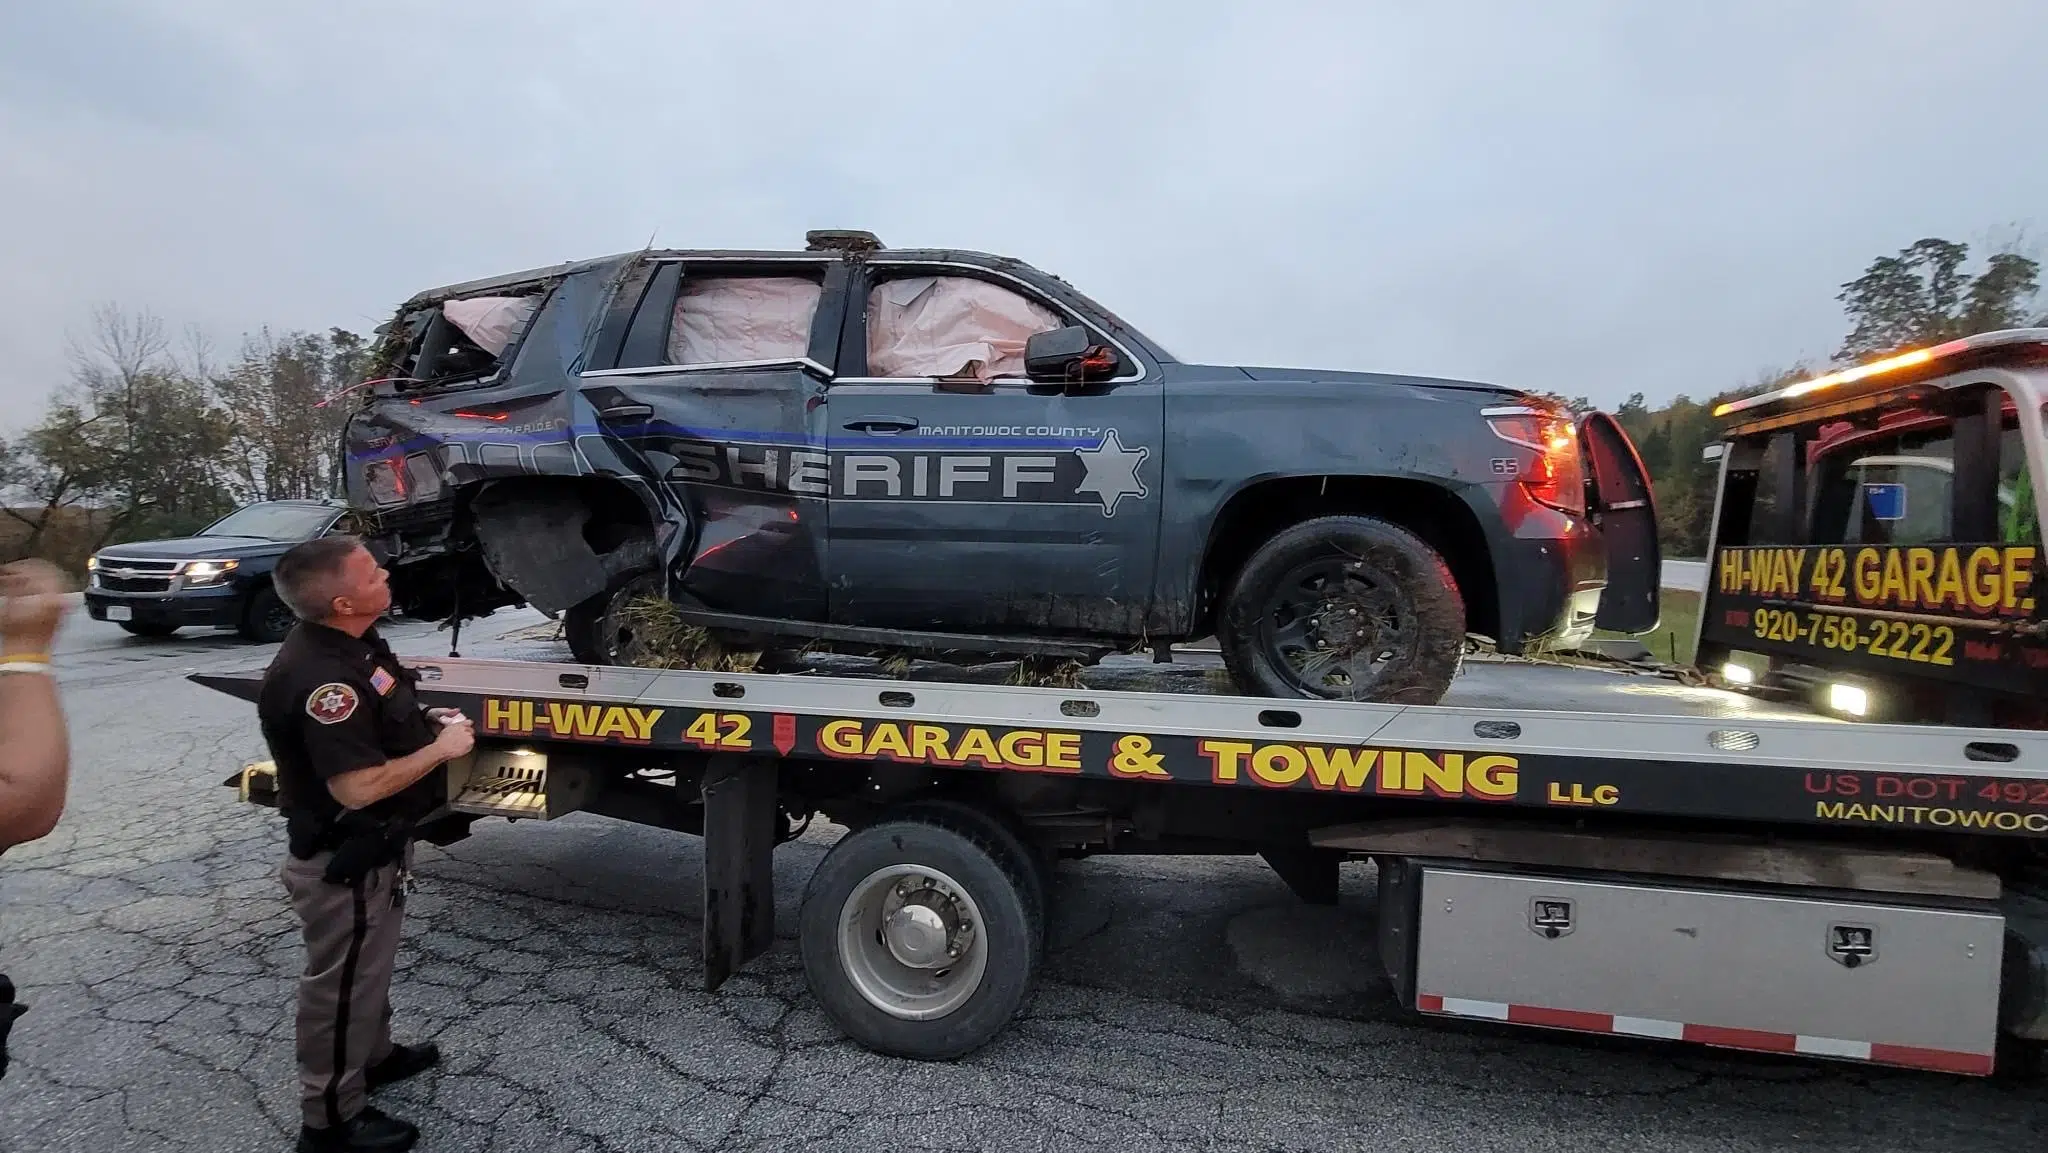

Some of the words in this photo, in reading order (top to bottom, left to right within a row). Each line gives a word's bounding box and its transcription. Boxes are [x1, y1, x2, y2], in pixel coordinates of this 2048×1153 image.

[919, 425, 1023, 437] MANITOWOC
[1025, 425, 1101, 438] COUNTY
[670, 443, 1057, 497] SHERIFF
[1489, 457, 1520, 475] 65
[1719, 548, 1806, 595] HI-WAY
[1811, 548, 1848, 598] 42
[1854, 547, 2036, 613] GARAGE
[1754, 608, 1955, 666] 920-758-2222
[484, 699, 665, 744] HI-WAY
[684, 713, 752, 750] 42
[817, 720, 1083, 773] GARAGE
[1108, 735, 1173, 779] &
[1198, 741, 1520, 799] TOWING
[1548, 782, 1620, 805] LLC
[1805, 773, 1861, 796] US
[1876, 775, 1969, 800] DOT
[1816, 801, 2048, 832] MANITOWOC
